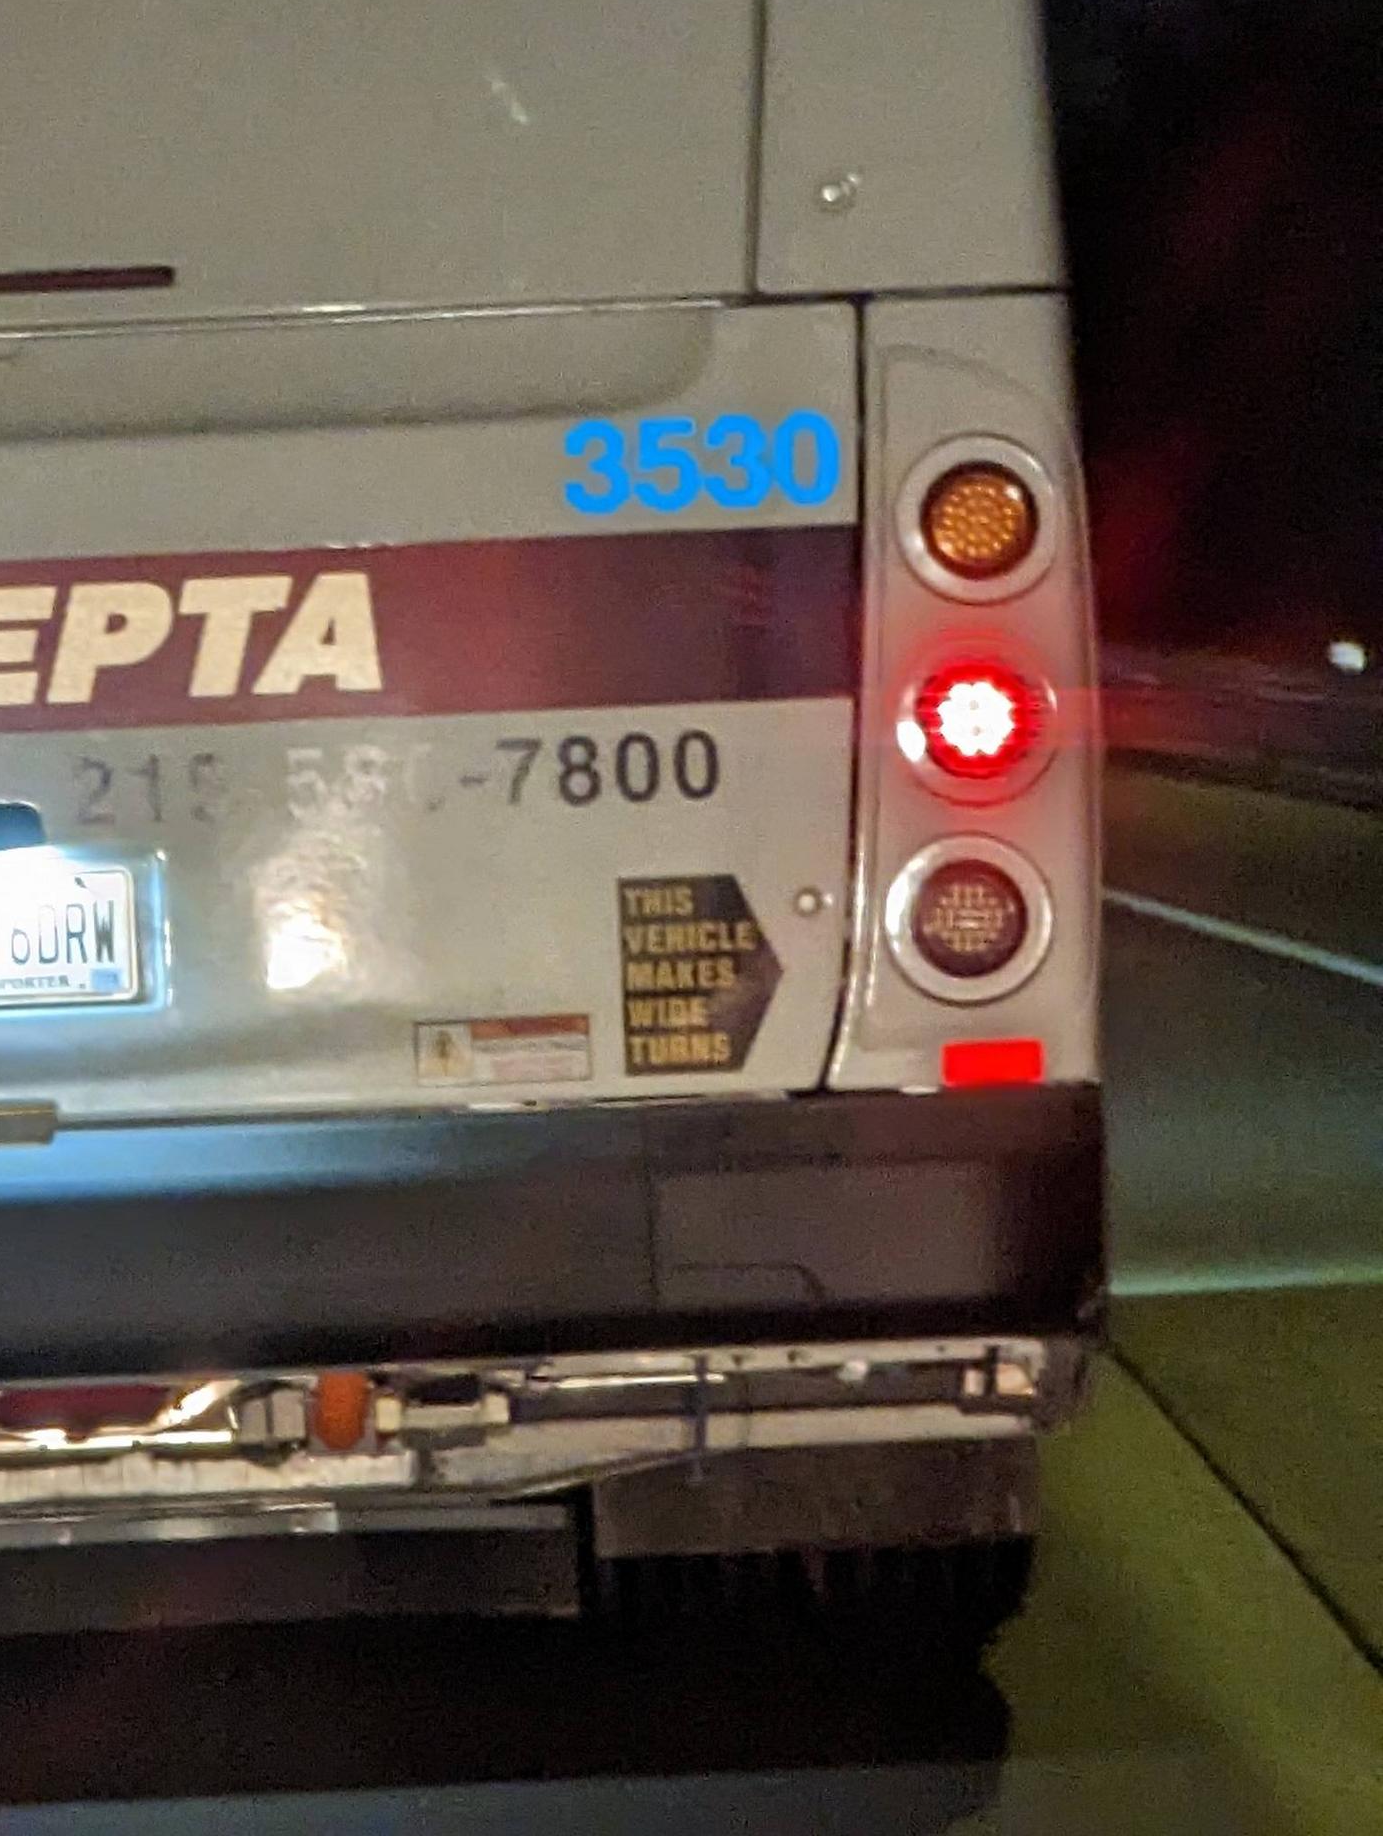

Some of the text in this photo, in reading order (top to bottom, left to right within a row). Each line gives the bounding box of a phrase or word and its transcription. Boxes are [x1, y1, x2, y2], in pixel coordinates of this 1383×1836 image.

[563, 409, 840, 515] 3530
[75, 727, 722, 826] 21558-7800
[622, 884, 694, 917] THIS
[623, 919, 760, 954] VEHICLE
[626, 956, 737, 991] MAKES
[628, 994, 711, 1028] WIDE
[630, 1031, 732, 1064] TURNS
